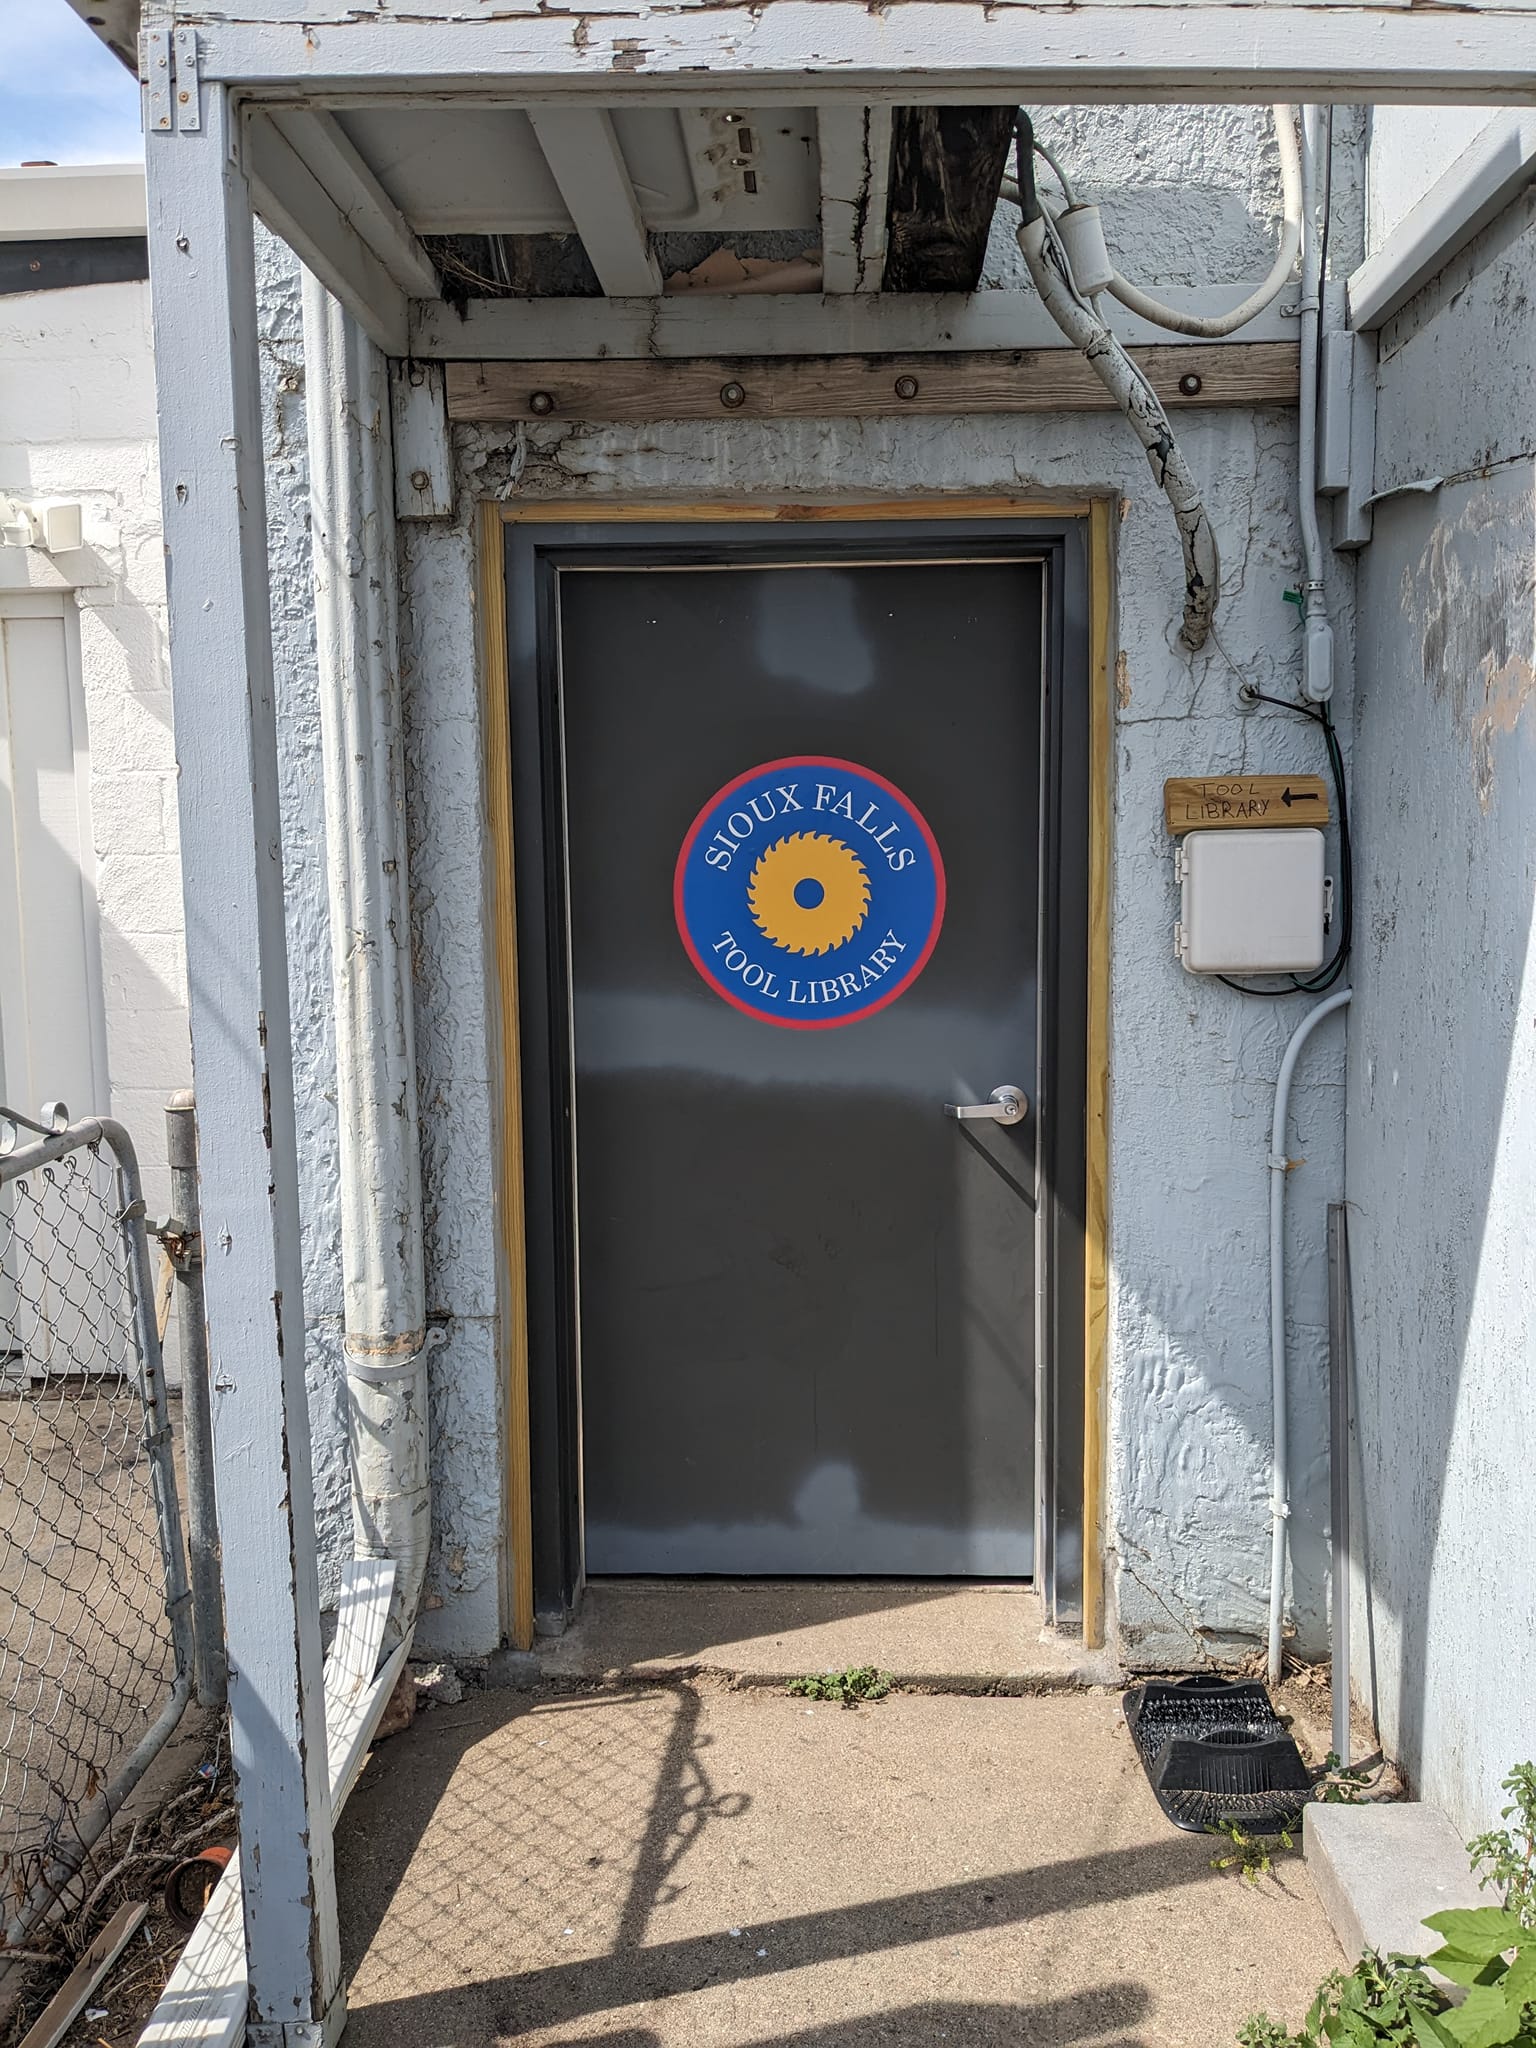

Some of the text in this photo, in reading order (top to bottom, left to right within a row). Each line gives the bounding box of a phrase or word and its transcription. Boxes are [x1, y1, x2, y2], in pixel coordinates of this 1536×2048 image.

[1185, 799, 1270, 820] LIBRARY
[1194, 783, 1260, 798] TOOL
[704, 783, 916, 871] SIOUX FALLS
[711, 929, 907, 1004] TOOL LIBRARY
